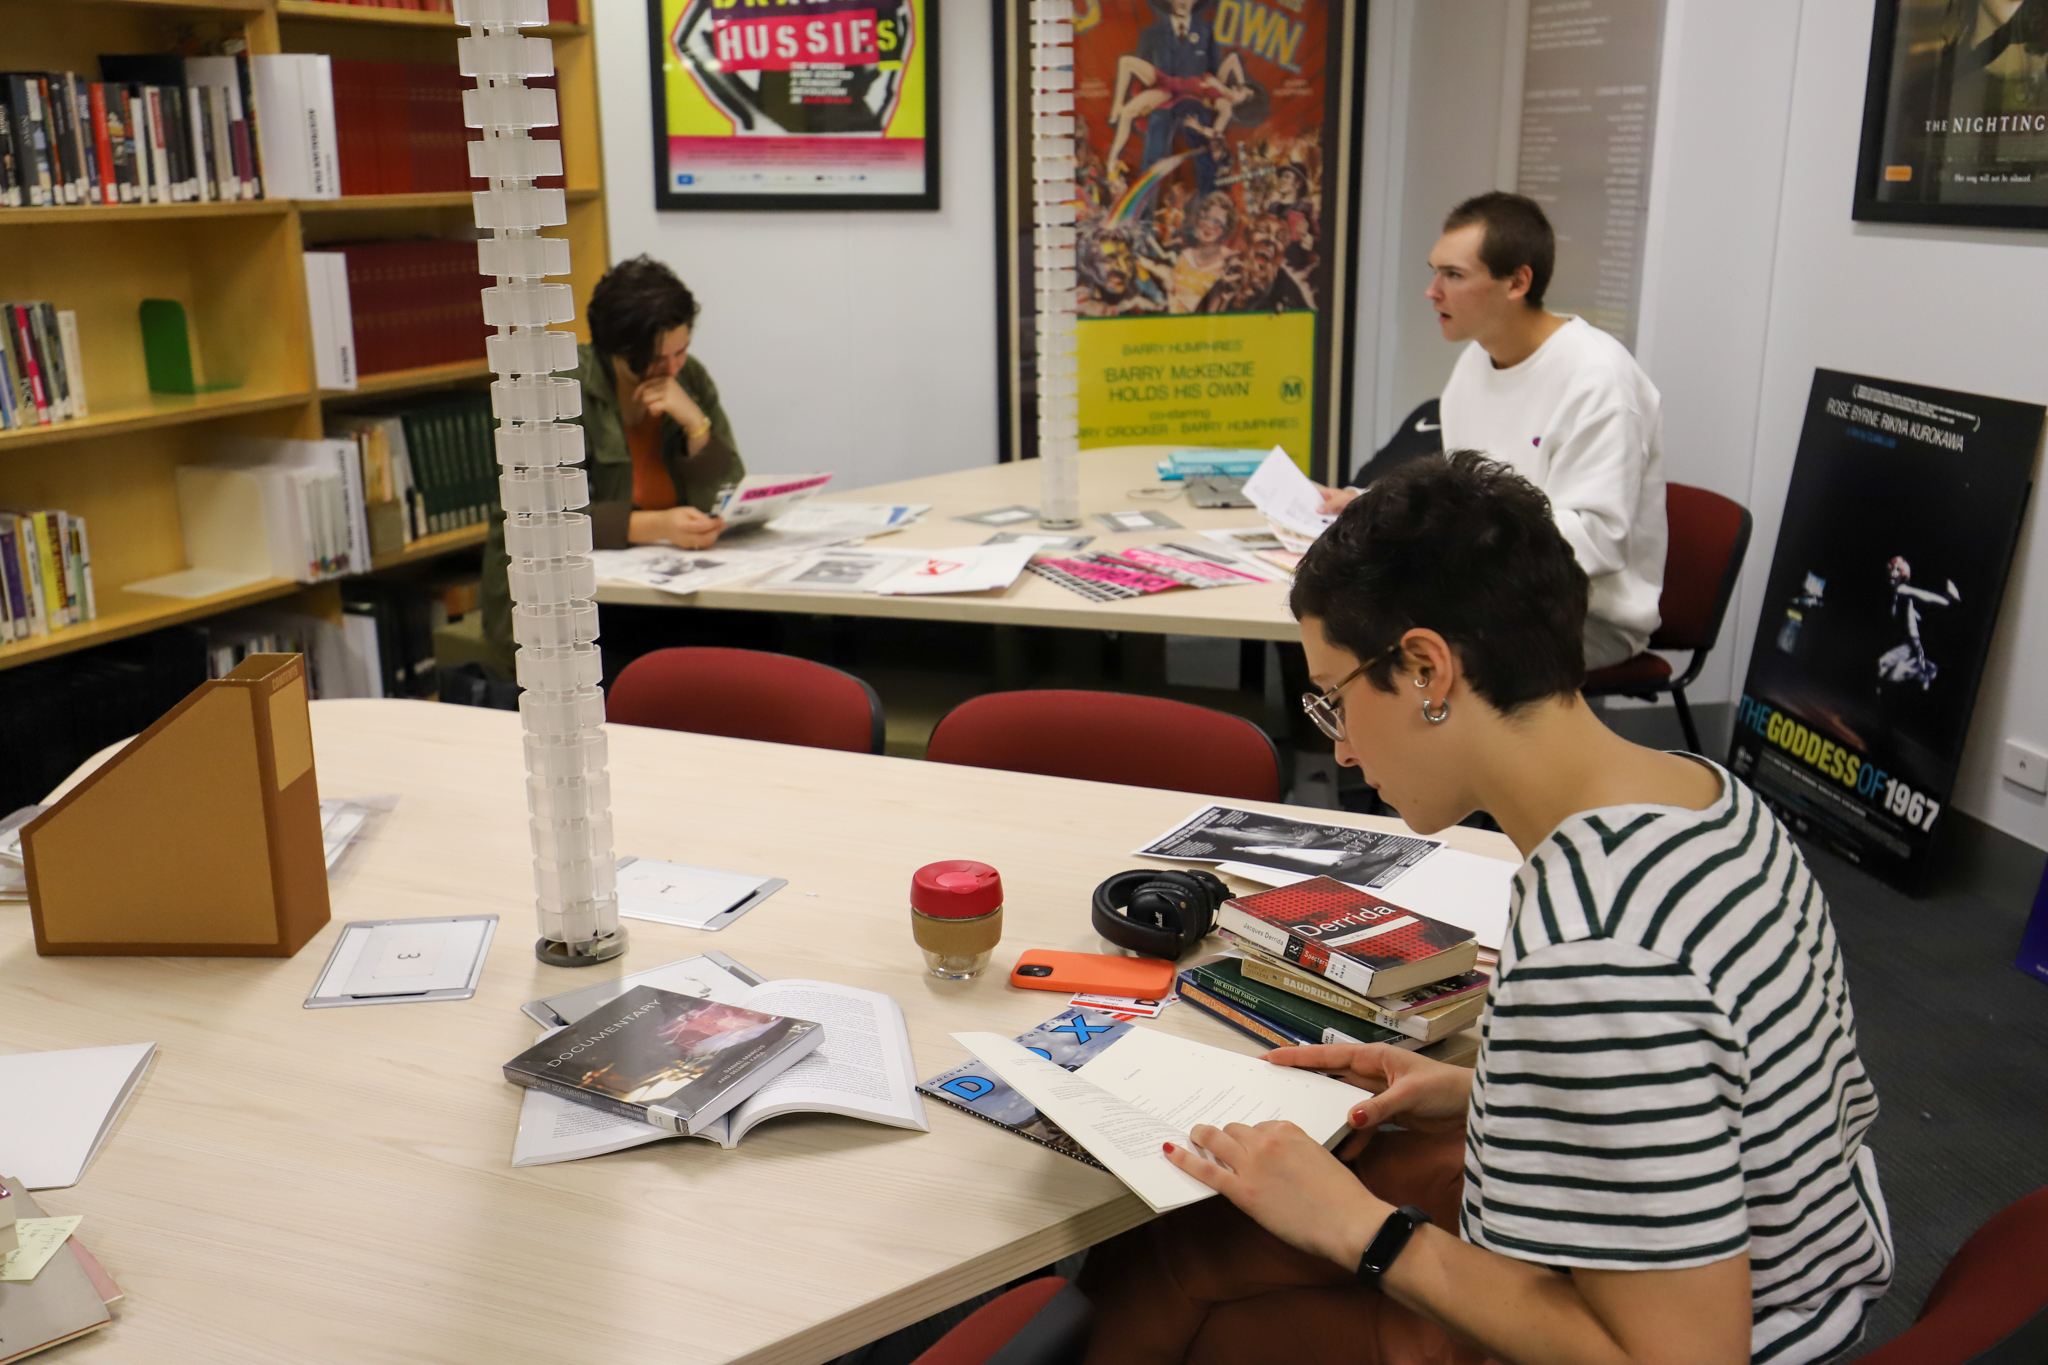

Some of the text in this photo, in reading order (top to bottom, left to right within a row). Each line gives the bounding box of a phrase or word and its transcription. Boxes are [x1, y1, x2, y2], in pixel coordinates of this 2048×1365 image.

[718, 19, 898, 61] HUSSIES
[1925, 114, 2048, 133] THE NIGHTING
[1979, 173, 1990, 182] will
[1991, 174, 2000, 182] not
[1171, 361, 1256, 380] McKENZIE
[1109, 384, 1169, 403] HOLDS
[1174, 383, 1202, 399] HIS
[1283, 383, 1302, 397] M
[1826, 397, 1851, 419] ROSE
[1851, 405, 1881, 427] BYRNE
[1908, 420, 1965, 453] KUROKAWA
[272, 664, 298, 691] CONTENTS
[1738, 693, 1773, 737] THE
[1767, 711, 1861, 788] GODDESS
[1857, 762, 1889, 799] OF
[1883, 777, 1941, 833] 1967
[1291, 905, 1397, 937] Derrida
[1242, 922, 1264, 938] Jacques
[1264, 931, 1284, 946] Derrida
[1303, 950, 1329, 967] Specters
[1213, 978, 1260, 1004] THE RITES OF PASSAGE
[1238, 997, 1257, 1010] GENNEP
[1283, 976, 1353, 1009] BAUDRILLARD
[1184, 985, 1281, 1045] Purity and Danger Mary Douglas
[547, 998, 661, 1068] DOCUMENTARY
[718, 1051, 766, 1084] AND SELMIN KARA
[723, 1044, 766, 1074] DANIEL MARCUS
[929, 1058, 981, 1087] DOCUMENT
[509, 1071, 592, 1102] CONTEMPORARY DOCUMENTARY
[632, 1105, 648, 1114] MARCU
[946, 1099, 1008, 1130] DOCUMENTARY
[1014, 1128, 1036, 1141] FILM
[1041, 1139, 1095, 1166] QUARTERLY
